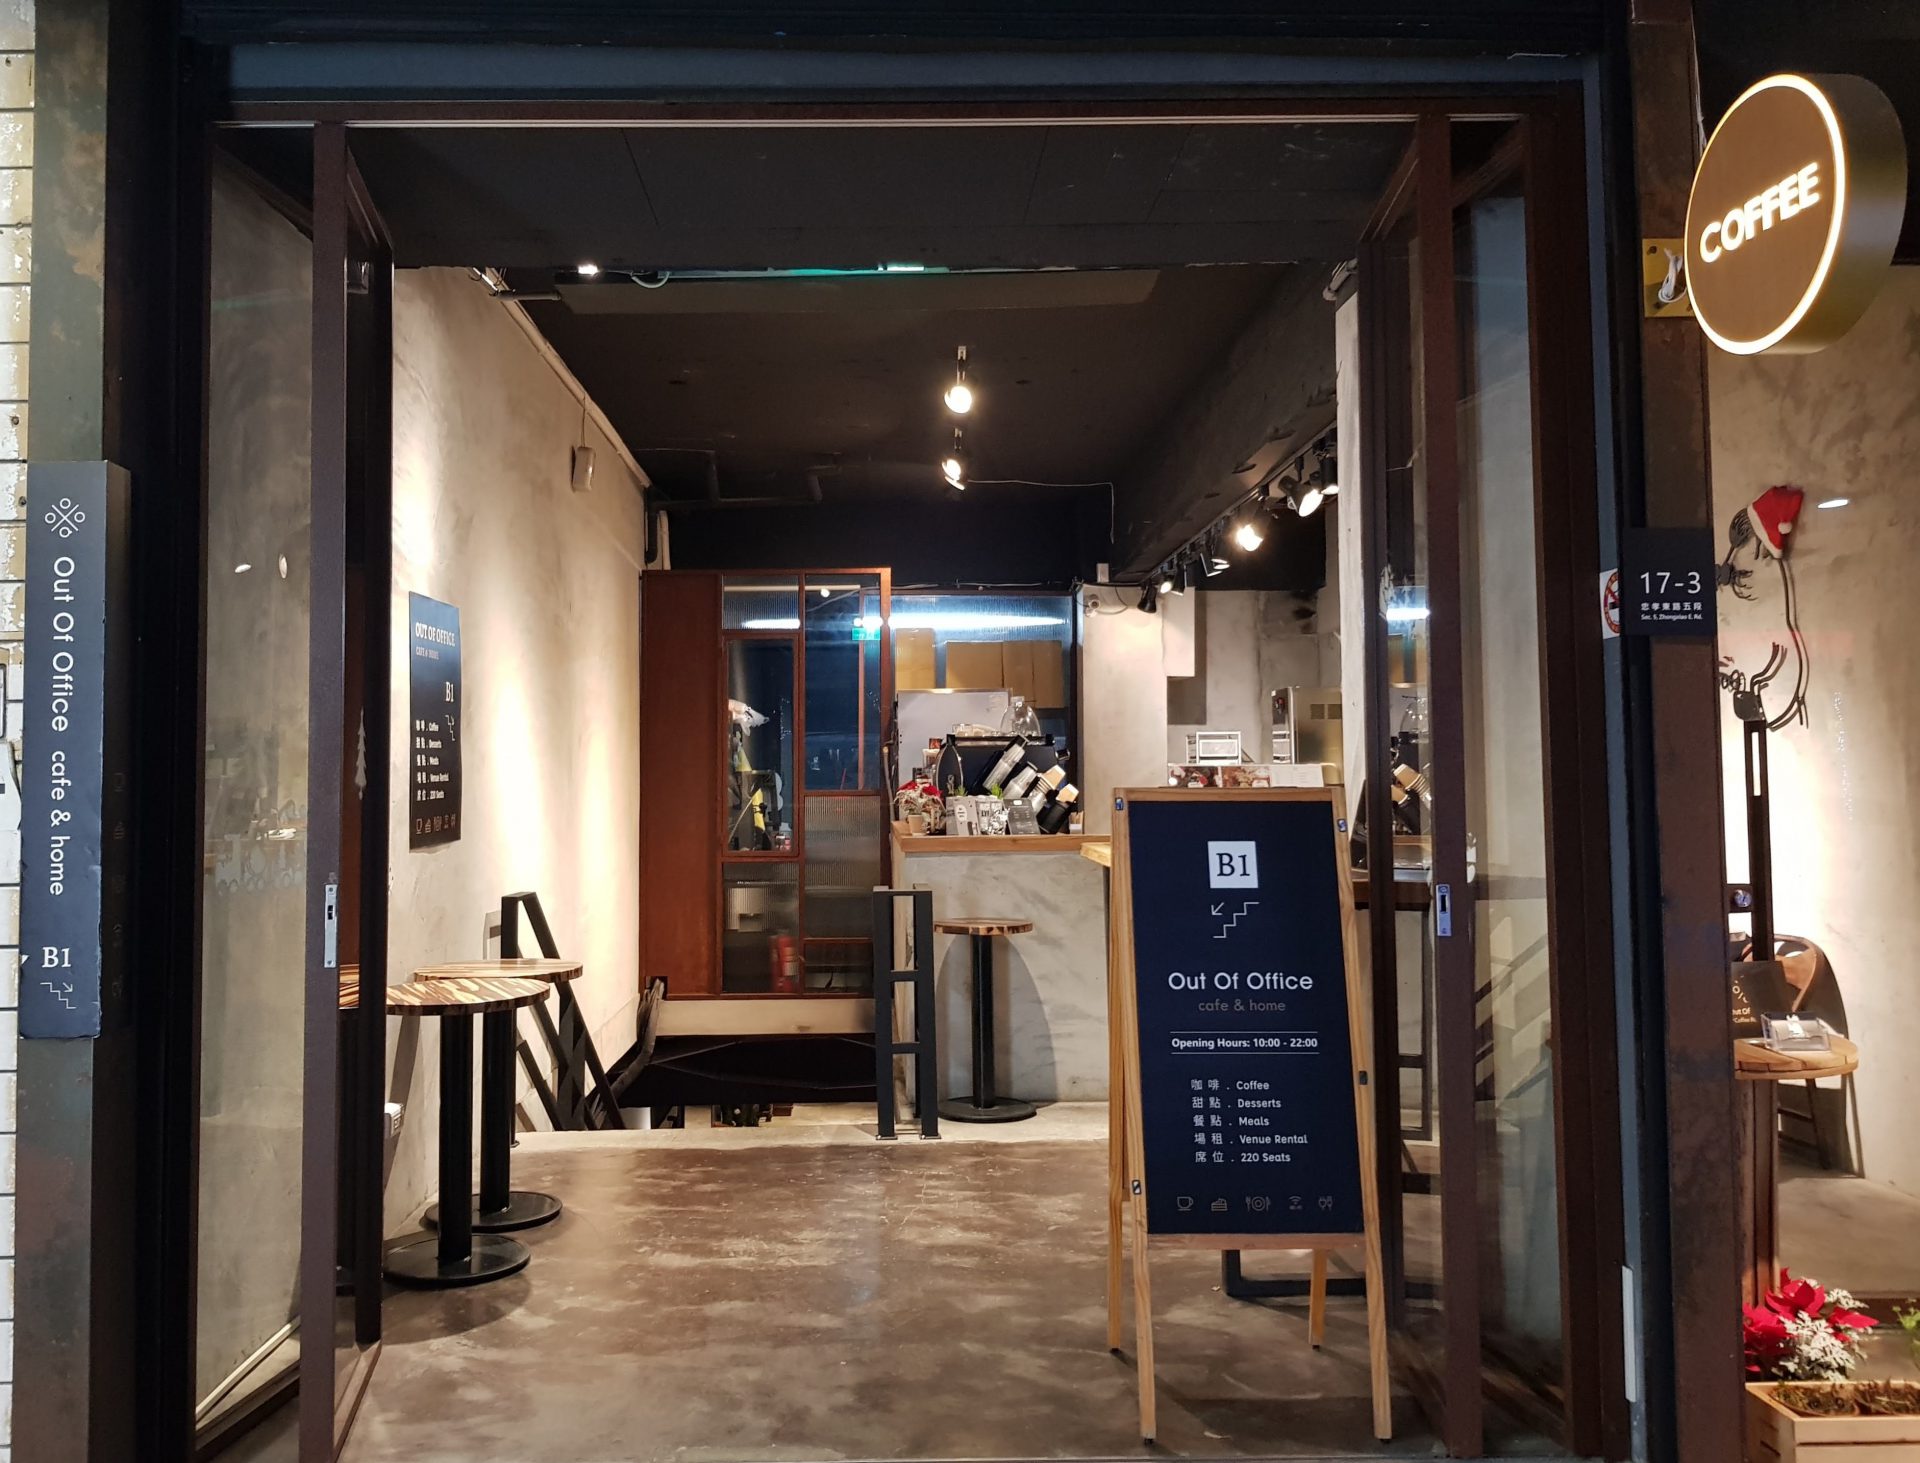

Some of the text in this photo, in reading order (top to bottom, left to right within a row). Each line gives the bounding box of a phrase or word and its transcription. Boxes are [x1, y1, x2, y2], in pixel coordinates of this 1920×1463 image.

[1700, 161, 1820, 263] COFFEE
[1640, 571, 1701, 594] 17-3
[415, 622, 456, 647] OUT OF OFFICE
[445, 681, 454, 702] B1
[50, 556, 75, 896] Out Of Office cafe & home
[1216, 852, 1251, 878] B1
[42, 946, 72, 968] B1
[1168, 972, 1313, 990] Out Of Office
[1198, 998, 1286, 1012] cafe & home
[1171, 1038, 1215, 1050] Opening
[1217, 1038, 1250, 1048] Hours:
[1253, 1038, 1280, 1048] 10:00
[1290, 1038, 1318, 1048] 22:00
[1236, 1081, 1270, 1090] Coffee
[1237, 1098, 1281, 1108] Desserts
[1238, 1116, 1270, 1126] Meals
[1240, 1134, 1271, 1144] Venue
[1274, 1134, 1308, 1144] Rental
[1240, 1153, 1259, 1162] 220
[1262, 1153, 1291, 1162] Seats
